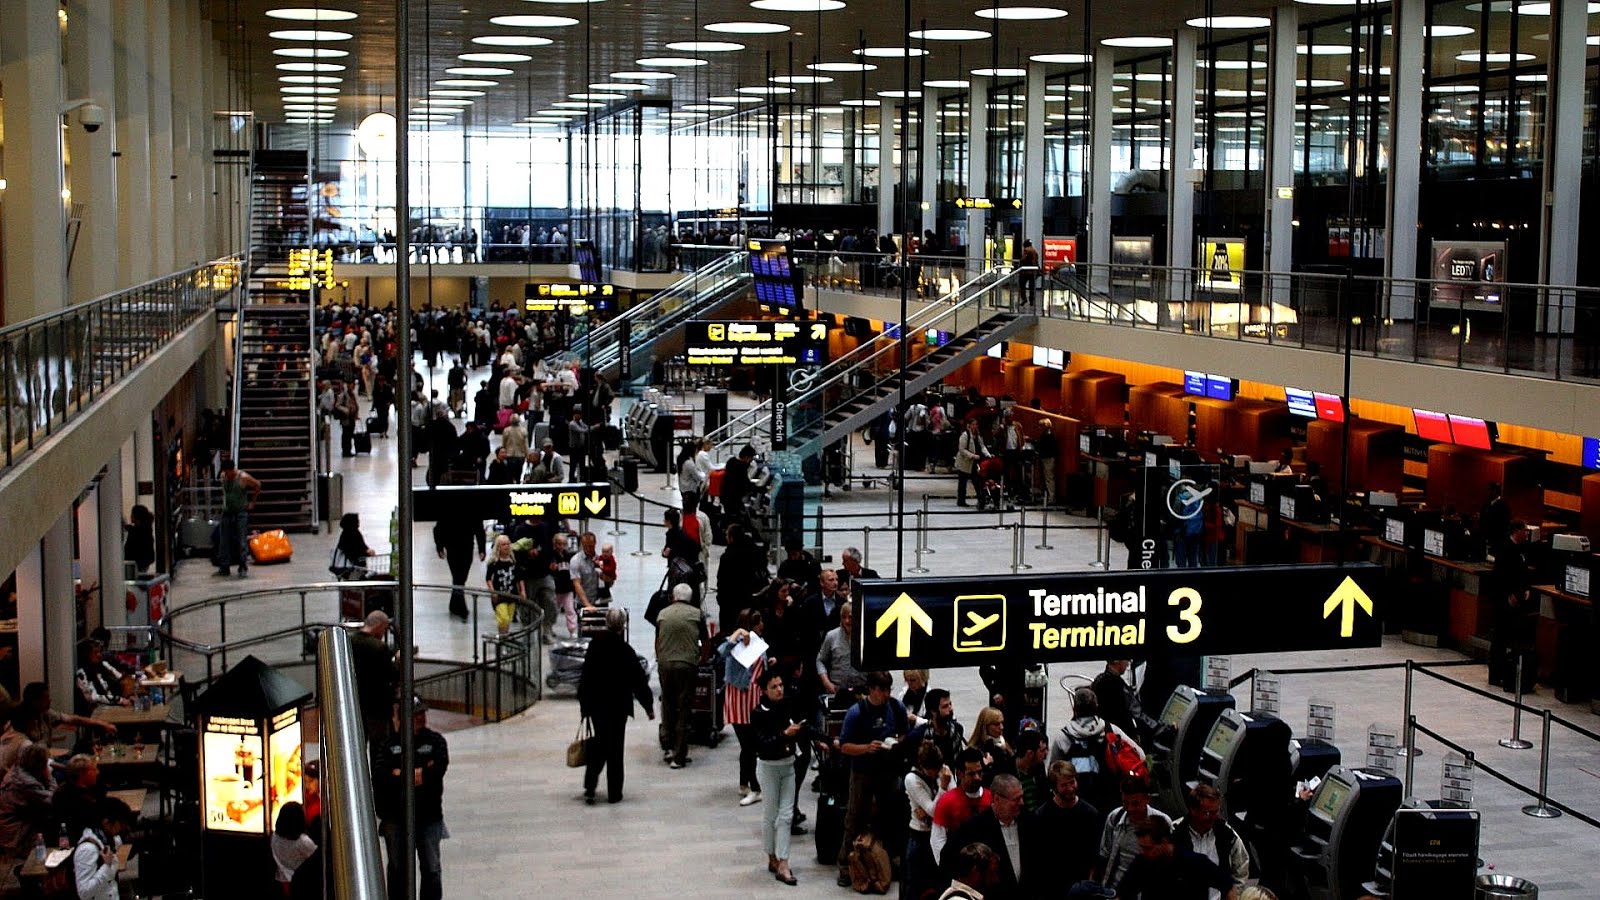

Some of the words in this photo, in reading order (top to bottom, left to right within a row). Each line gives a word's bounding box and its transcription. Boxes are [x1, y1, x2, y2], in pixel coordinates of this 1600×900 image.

[775, 401, 785, 442] Check-in
[509, 504, 545, 516] Toilets
[1028, 585, 1146, 617] Terminal
[1165, 586, 1203, 644] 3
[1028, 618, 1146, 649] Terminal
